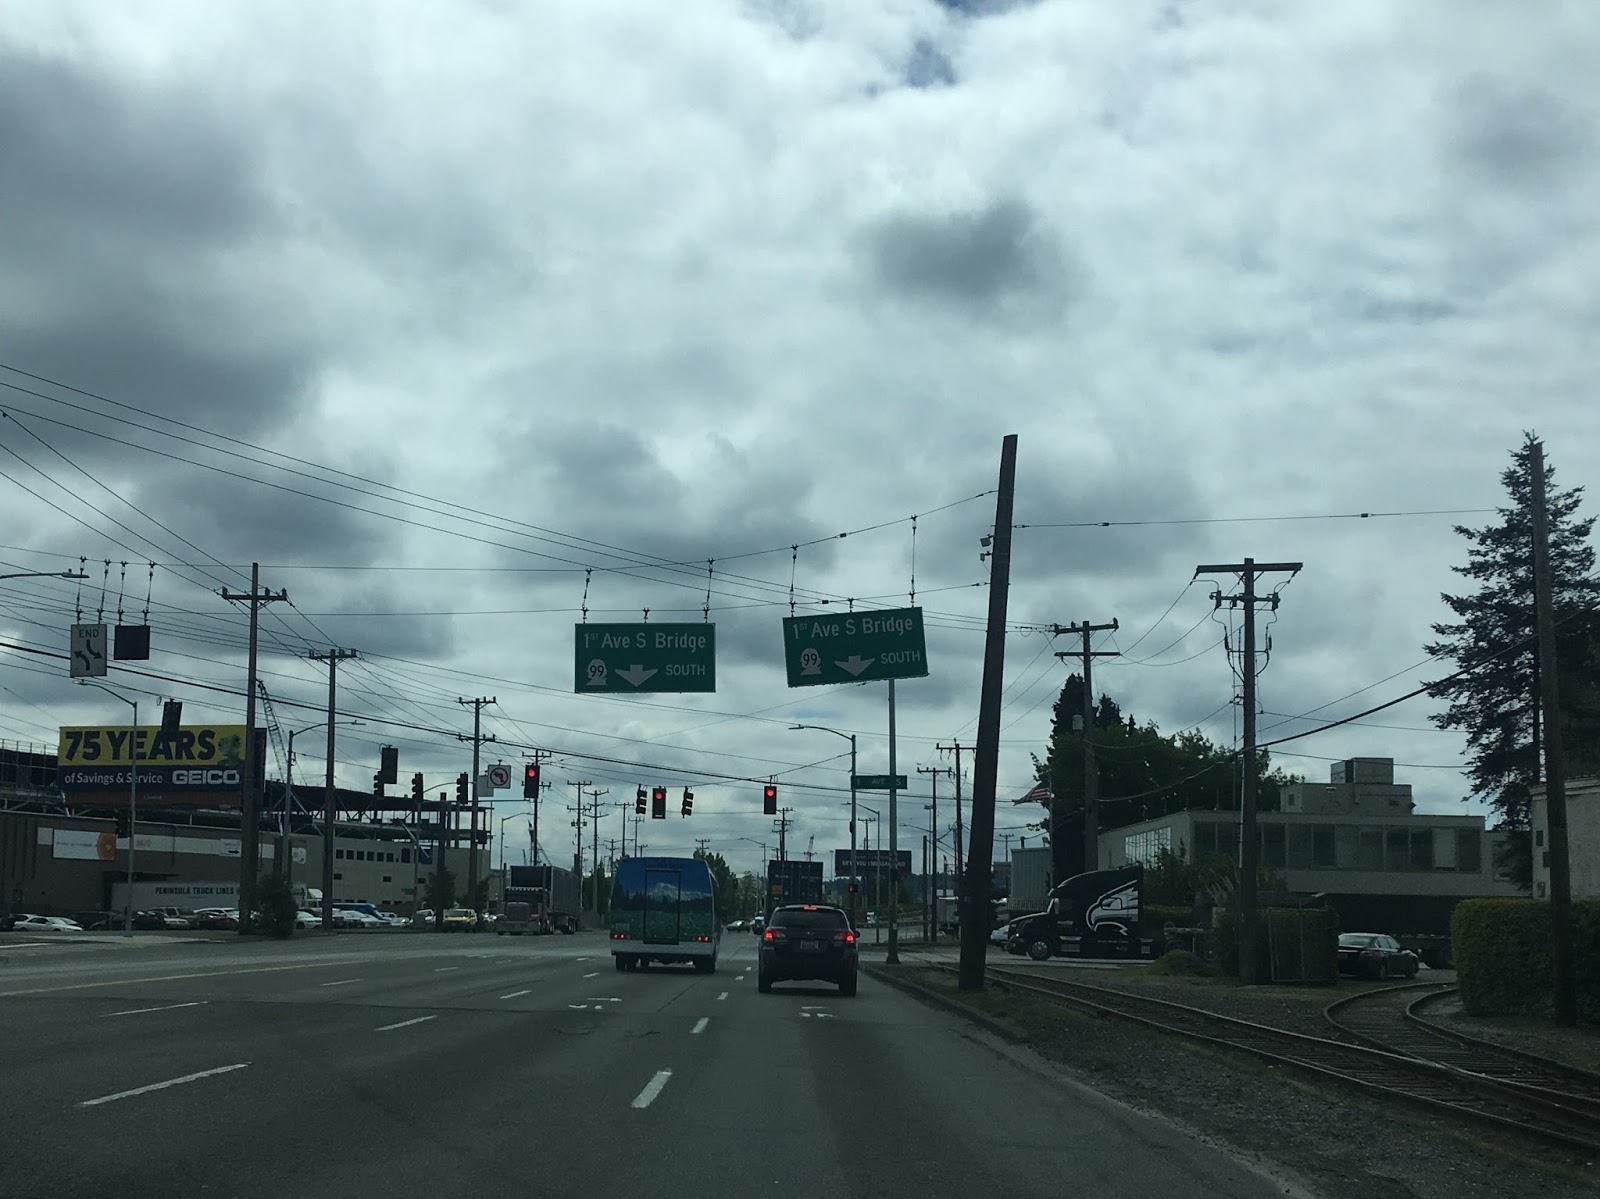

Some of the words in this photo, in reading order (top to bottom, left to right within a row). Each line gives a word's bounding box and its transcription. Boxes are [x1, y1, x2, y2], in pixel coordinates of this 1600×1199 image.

[79, 629, 99, 638] END
[811, 622, 840, 638] Ave
[845, 619, 857, 635] S
[862, 616, 913, 636] Bridge
[601, 632, 631, 649] Ave
[636, 632, 647, 649] S
[655, 632, 706, 653] Bridge
[803, 653, 818, 666] 99
[880, 650, 921, 665] SOUTH
[589, 665, 605, 678] 99
[665, 664, 706, 676] SOUTH
[65, 730, 101, 761] 75
[106, 729, 216, 761] YEARS
[64, 772, 76, 784] of
[76, 772, 114, 786] Savings
[116, 772, 124, 783] &
[171, 769, 240, 785] GEICO
[895, 778, 902, 786] S
[154, 887, 191, 895] PENINSULA
[192, 887, 214, 895] TRUCK
[215, 887, 234, 895] LINES
